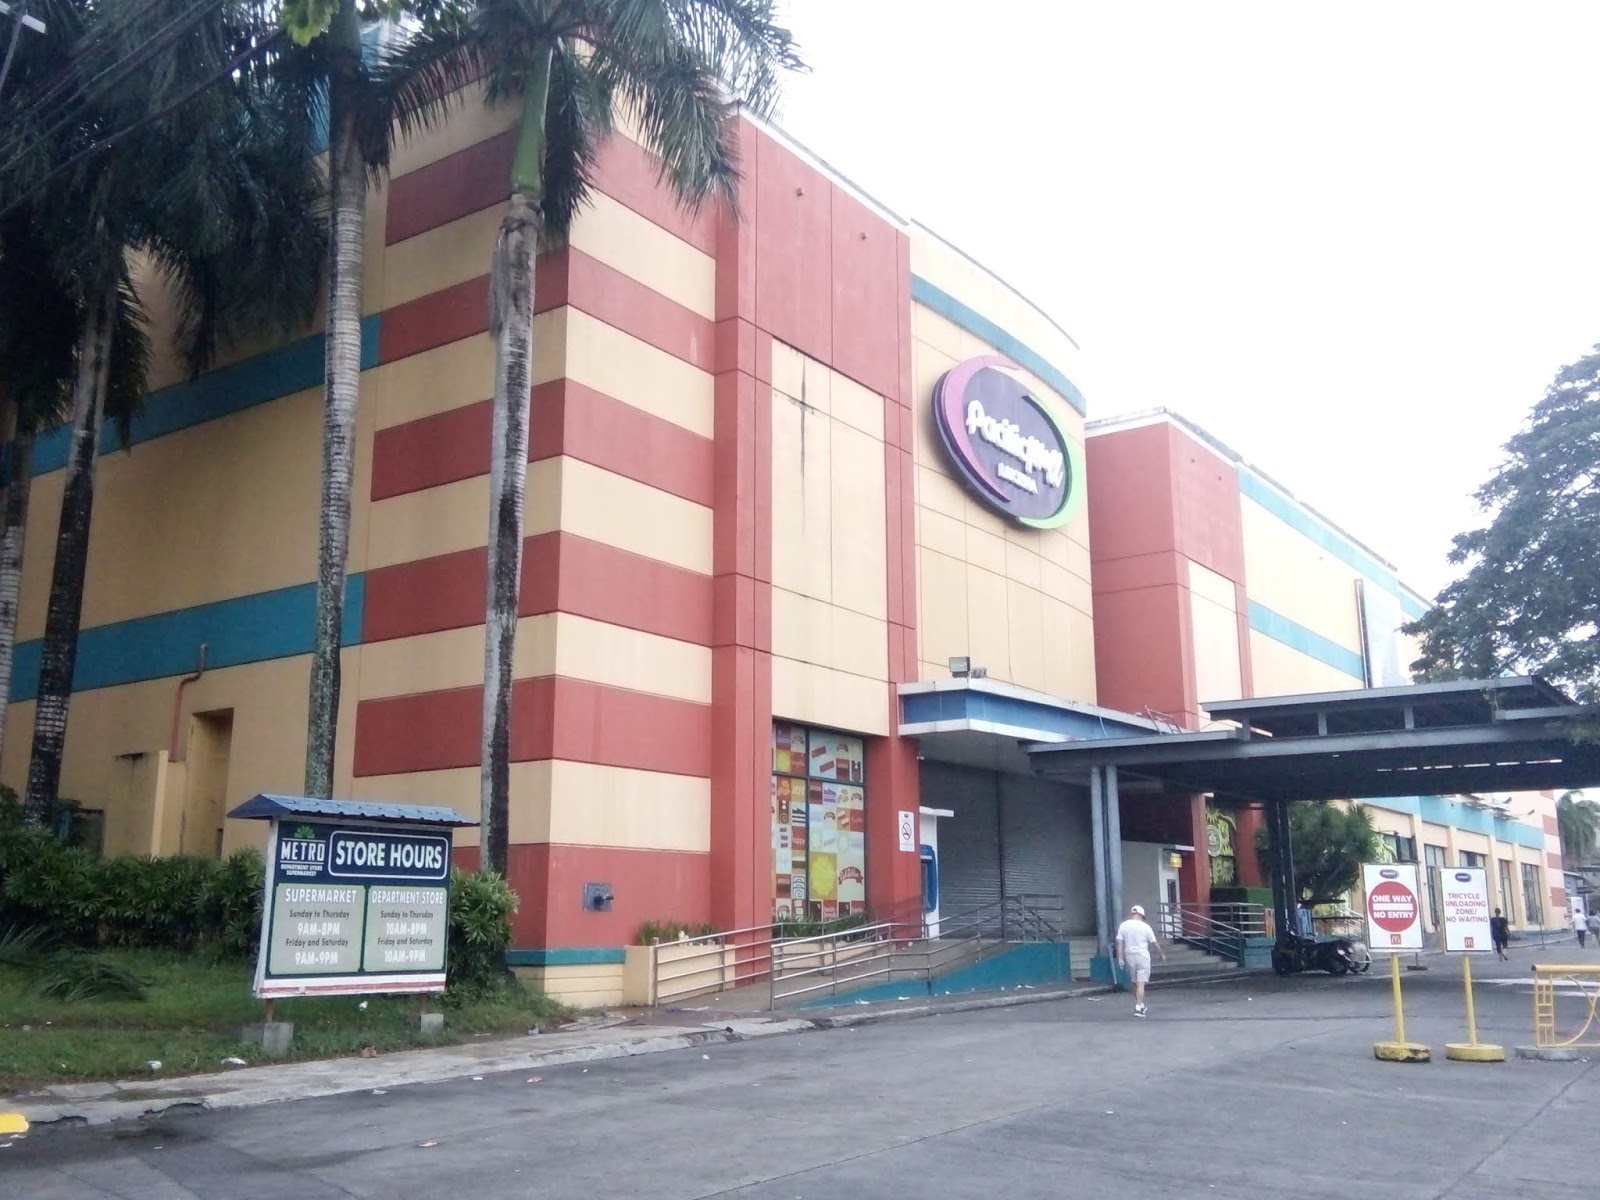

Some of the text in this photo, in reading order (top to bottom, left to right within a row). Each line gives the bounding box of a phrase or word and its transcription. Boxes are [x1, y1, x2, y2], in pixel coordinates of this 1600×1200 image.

[281, 841, 325, 862] METRO
[336, 840, 442, 869] STORE HOURS
[281, 863, 308, 871] DEPARTMENT
[285, 888, 357, 903] SUPERMARKET
[372, 890, 444, 904] DEPARTMENT STORE
[1372, 894, 1412, 903] ONE WAY
[1448, 892, 1480, 900] TRICYCLE
[289, 909, 350, 920] Sunday to Thursday
[380, 910, 400, 919] Sunday
[409, 910, 434, 919] Thursday
[1388, 911, 1414, 919] ENTRY
[297, 922, 340, 936] 9AM-8PM
[386, 922, 427, 935] 10AM-8PM
[285, 938, 349, 948] Friday and Saturday
[377, 938, 395, 947] Friday
[409, 937, 433, 946] Saturday
[295, 951, 338, 965] 9AM-9PM
[384, 949, 426, 963] 10AM-9PM
